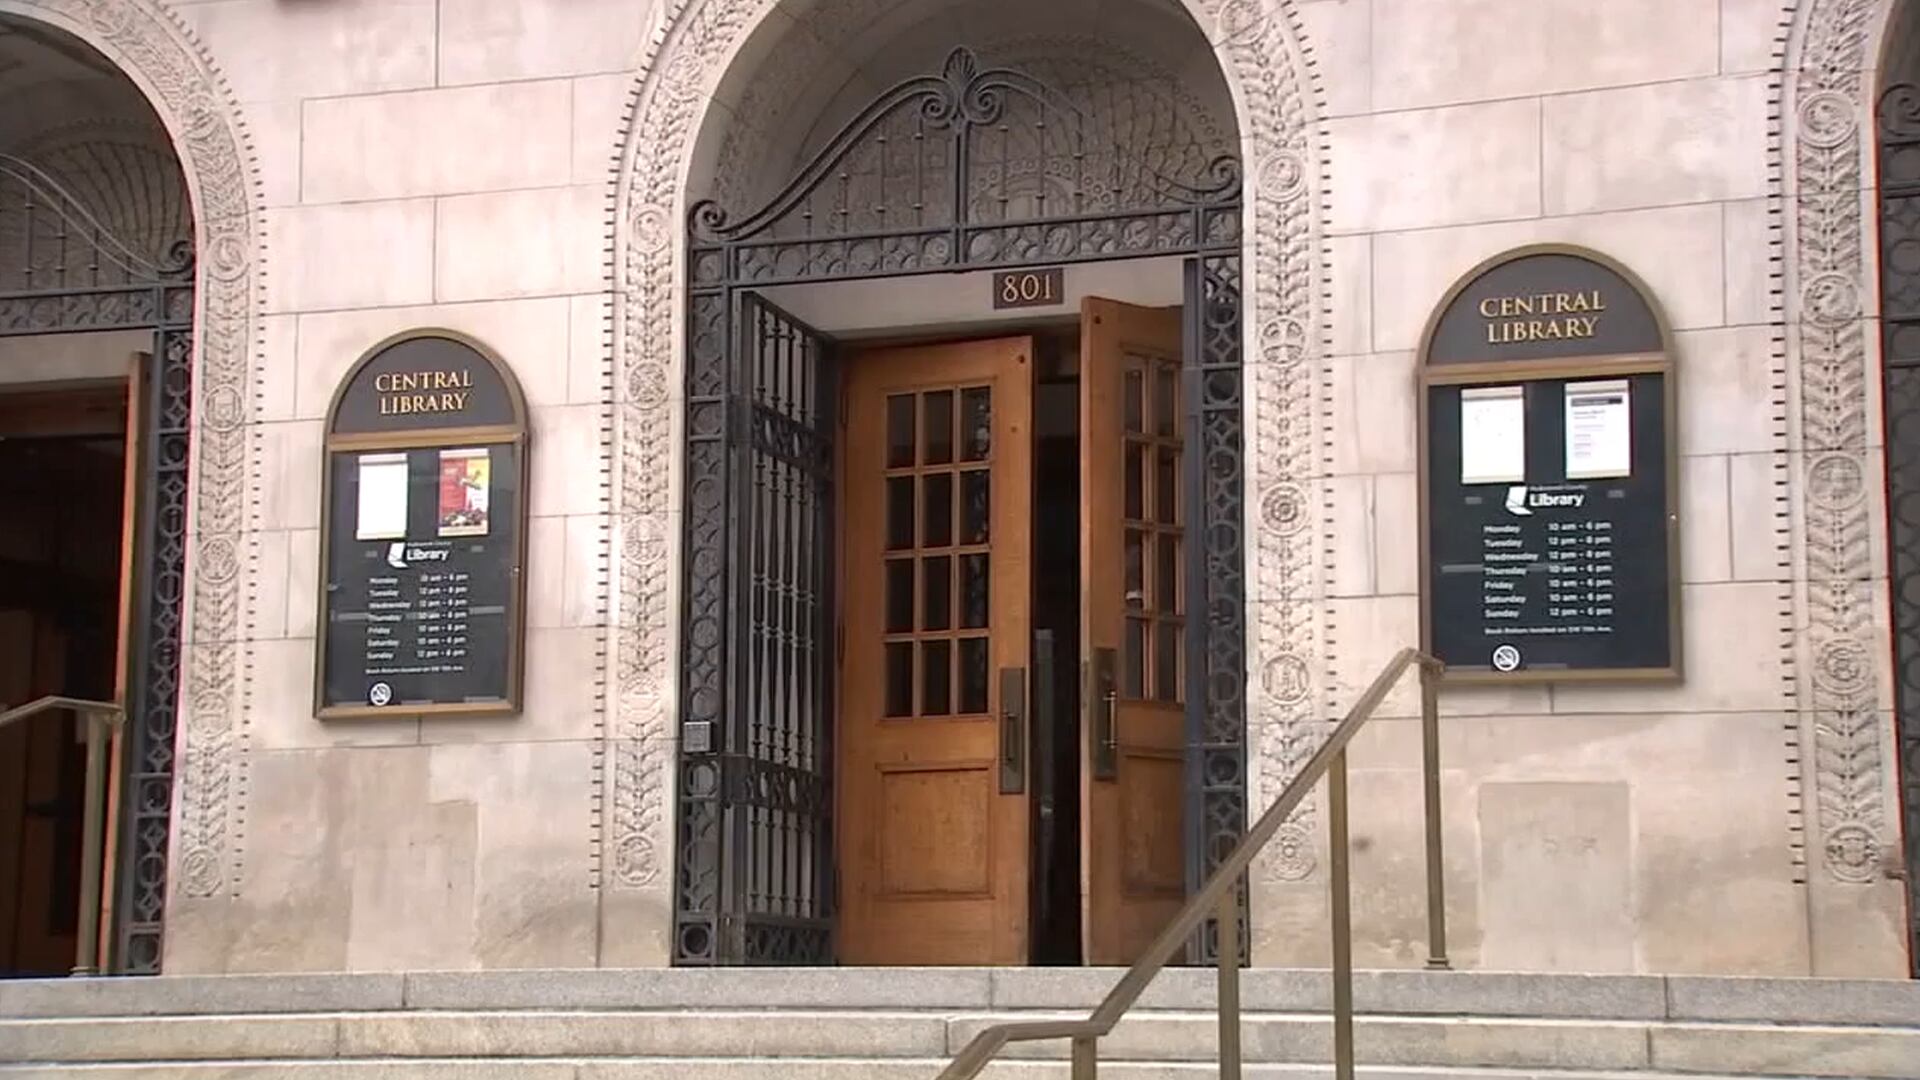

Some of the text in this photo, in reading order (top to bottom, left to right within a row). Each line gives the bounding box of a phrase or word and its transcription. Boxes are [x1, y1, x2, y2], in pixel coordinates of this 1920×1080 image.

[1002, 274, 1051, 302] 801
[1479, 289, 1607, 318] CENTRAL
[1487, 316, 1599, 343] LIBRARY
[374, 367, 475, 392] CENTRAL
[380, 391, 470, 414] LIBRARY
[1529, 492, 1585, 507] Library
[1483, 525, 1521, 534] Monday
[1484, 538, 1523, 548] Tuesday
[406, 549, 450, 561] Library
[1484, 552, 1539, 561] Wednesday
[1484, 566, 1527, 576] Thursday
[1484, 581, 1514, 590] Friday
[1484, 595, 1527, 604] Saturday
[1485, 609, 1520, 618] Sunday
